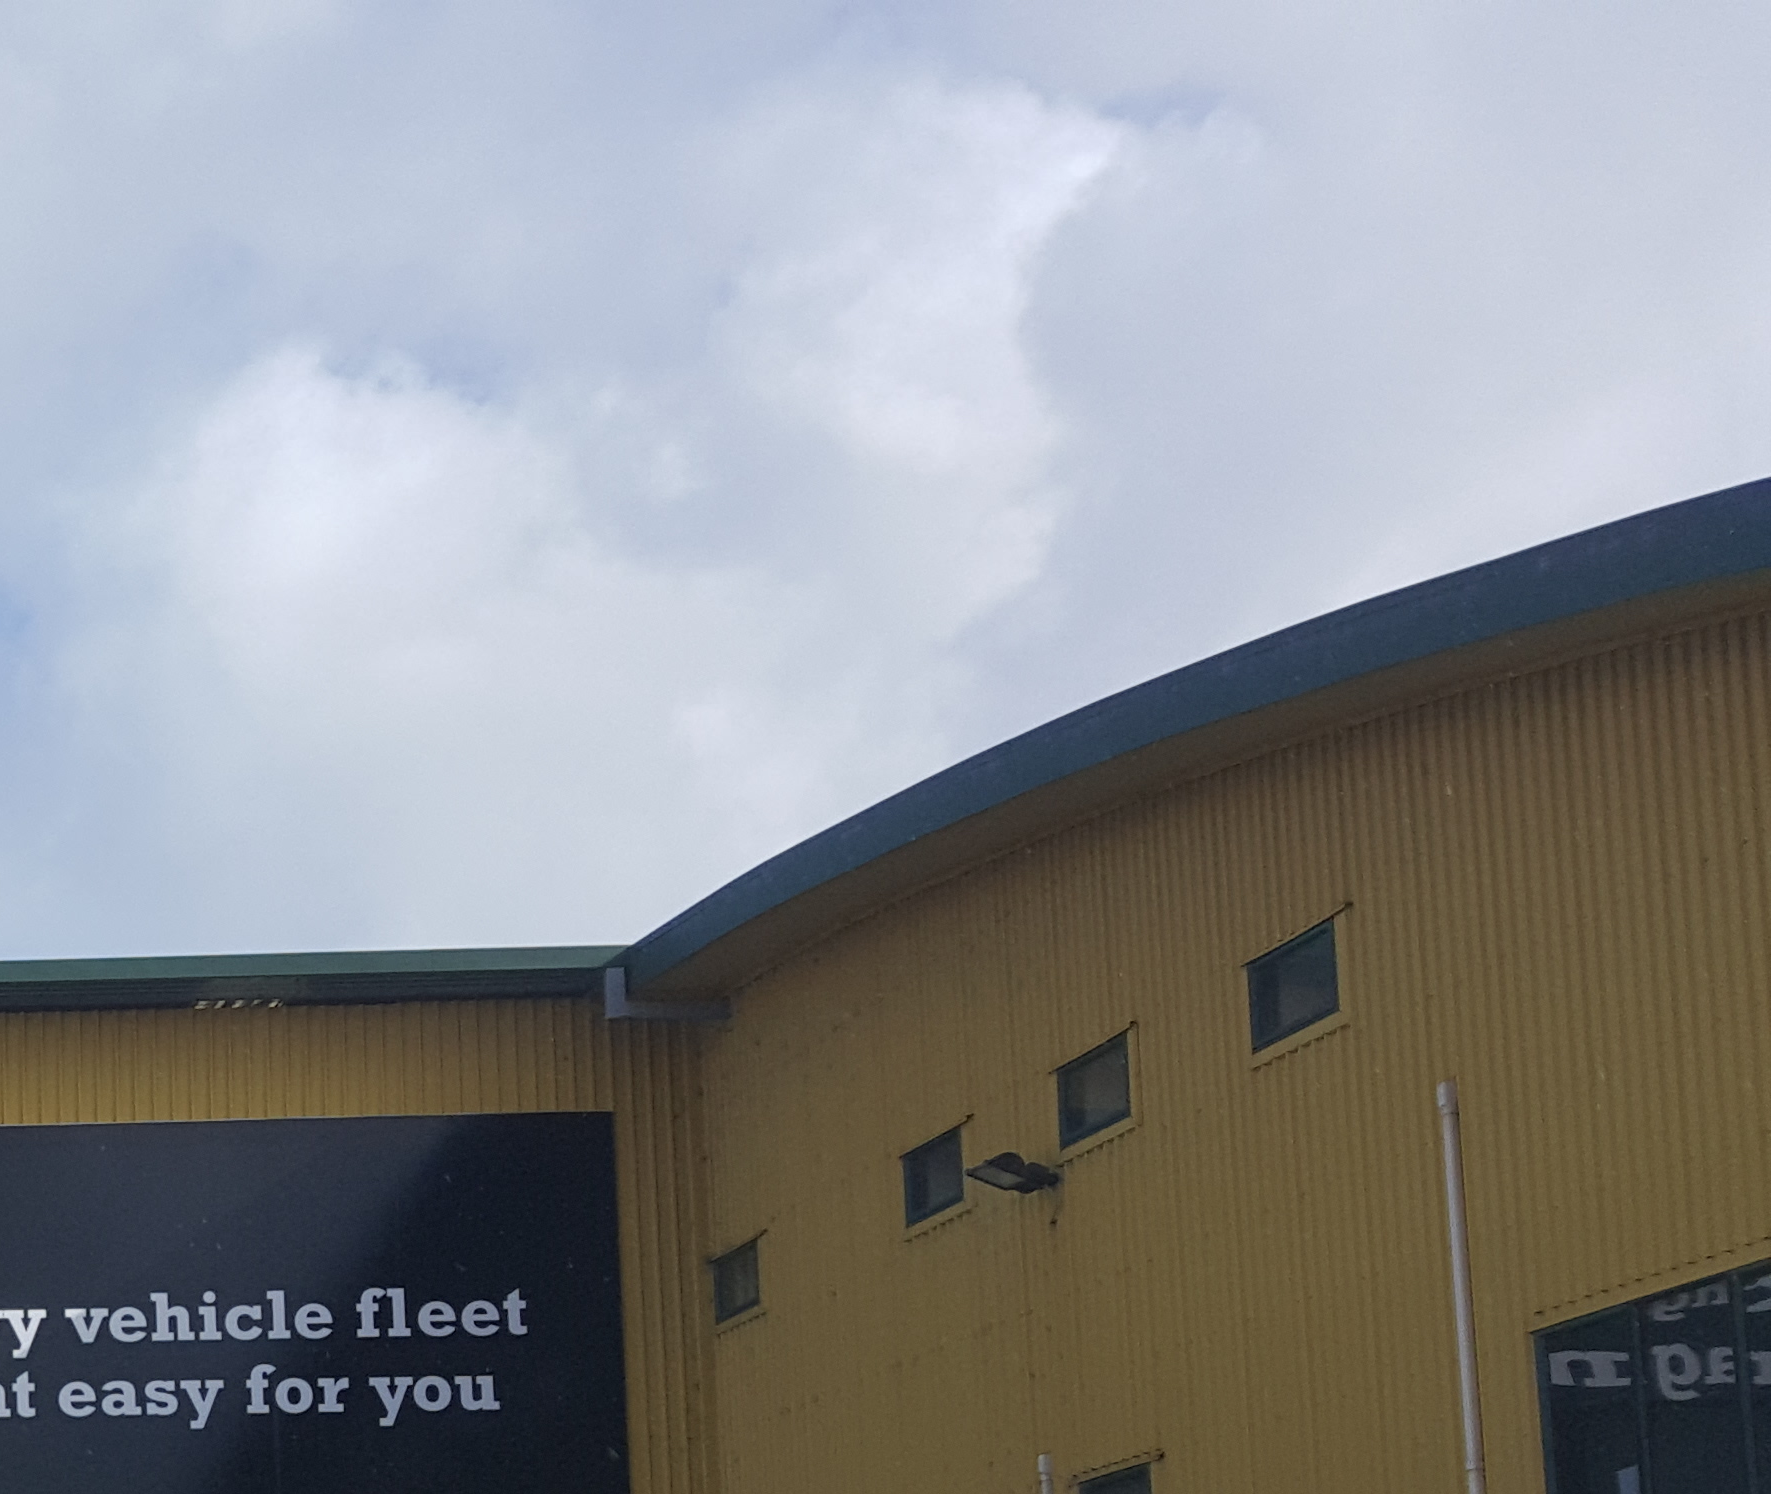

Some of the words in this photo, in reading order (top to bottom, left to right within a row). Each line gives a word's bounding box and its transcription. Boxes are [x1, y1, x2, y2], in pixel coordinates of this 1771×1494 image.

[64, 1290, 333, 1343] vehicle
[355, 1287, 528, 1338] fleet
[58, 1379, 225, 1430] easy
[245, 1363, 350, 1414] for
[368, 1375, 500, 1427] you
